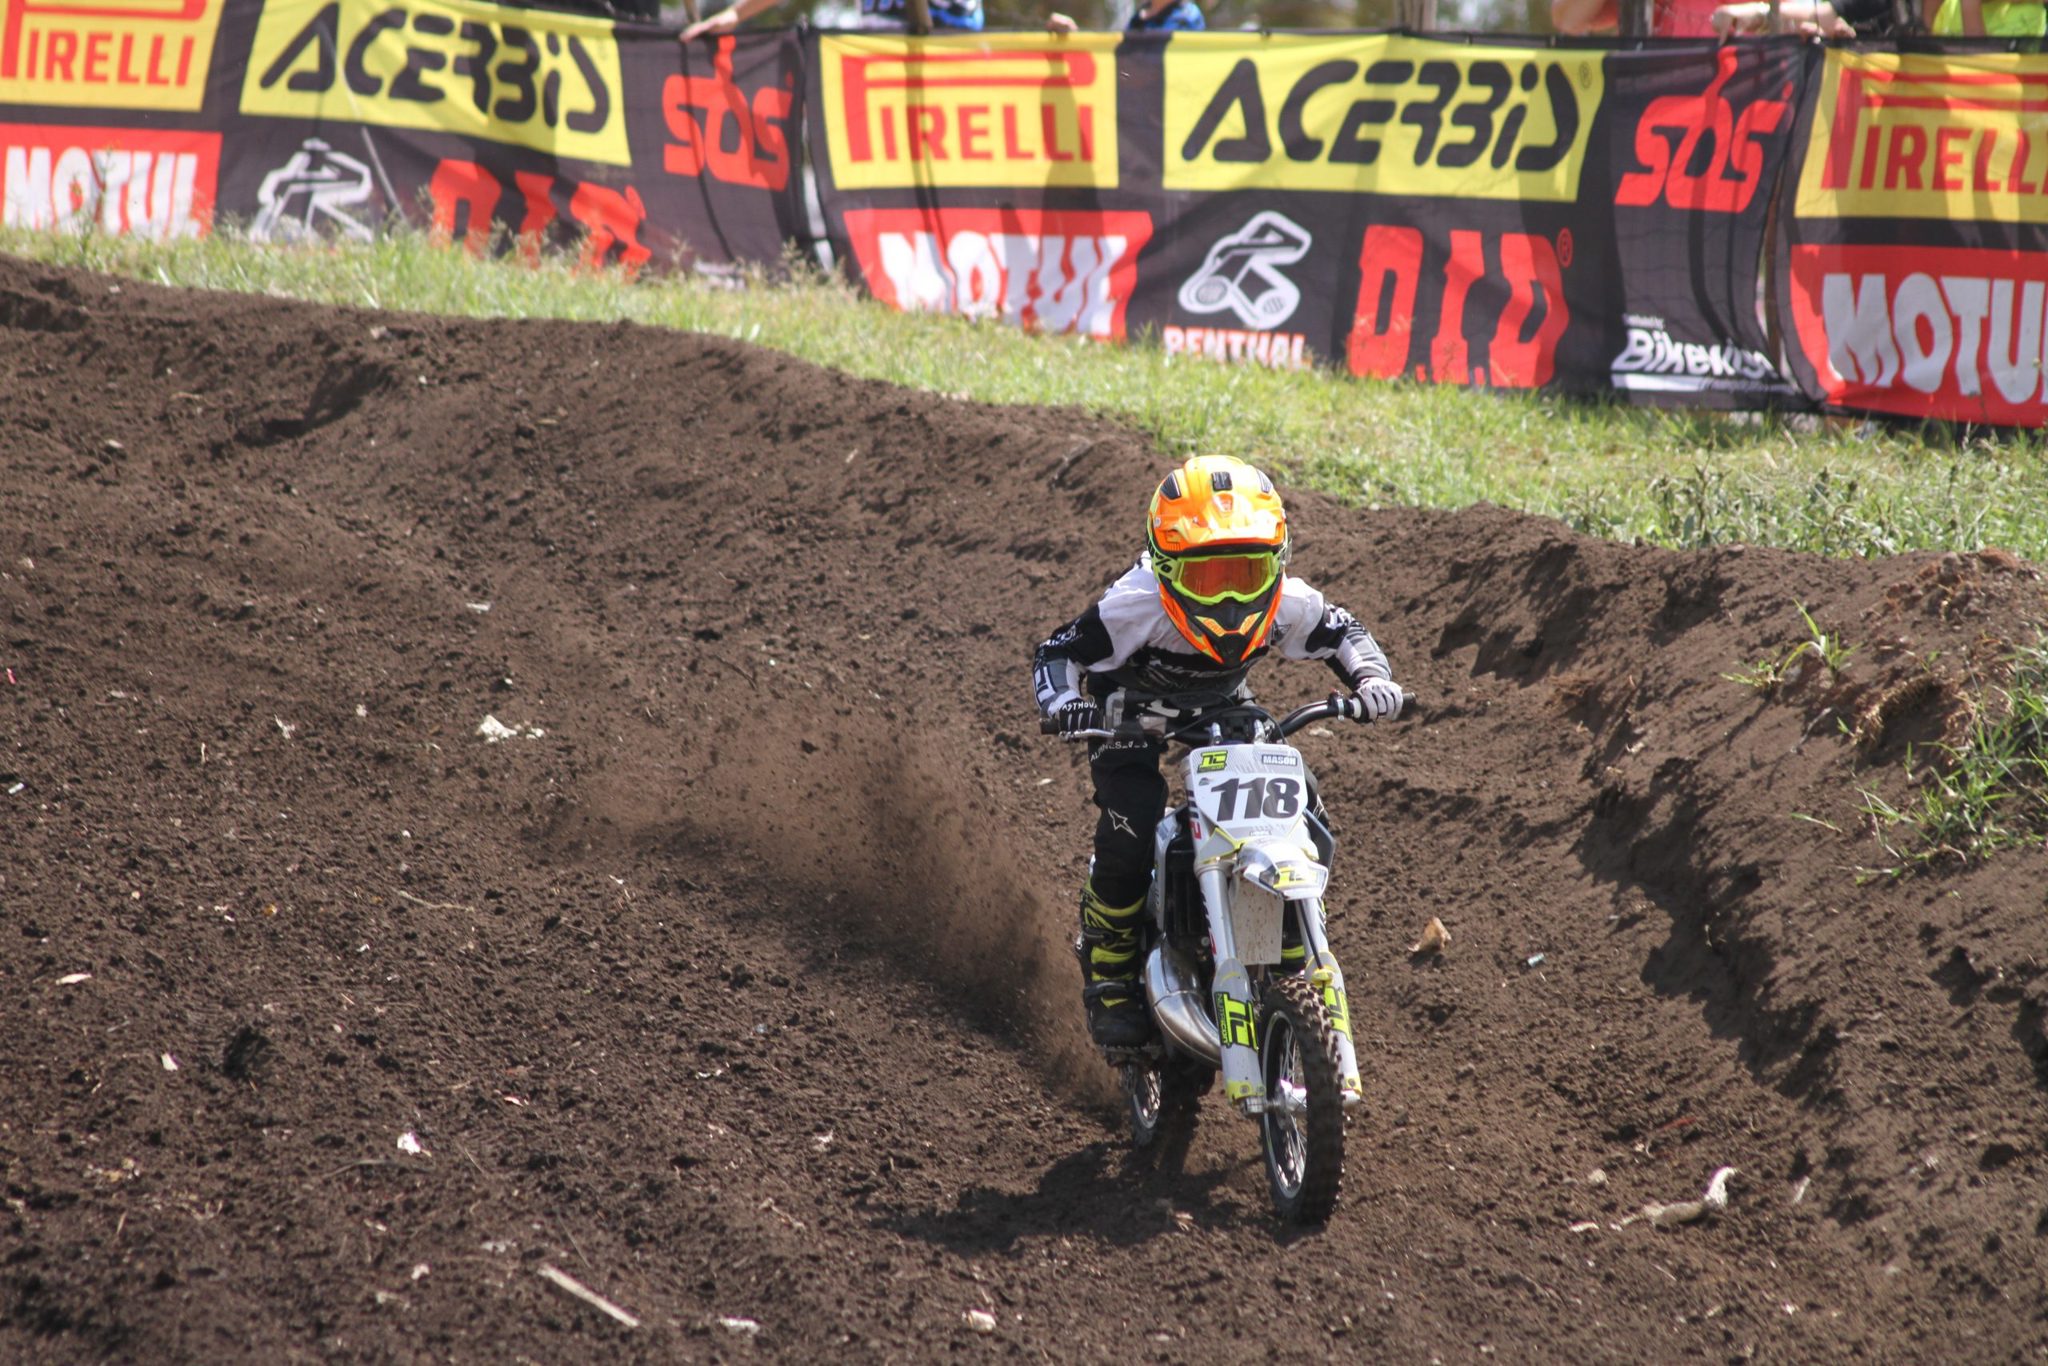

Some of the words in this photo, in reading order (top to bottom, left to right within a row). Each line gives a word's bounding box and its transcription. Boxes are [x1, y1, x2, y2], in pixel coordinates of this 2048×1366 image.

[1, 0, 207, 87] PIRELLI
[260, 2, 611, 134] ACERBIS
[841, 50, 1097, 162] PIRELLI
[1181, 58, 1580, 172] ACERBIS
[4, 145, 200, 240] MOTUL
[878, 229, 1127, 336] MOTUL
[1821, 272, 2048, 405] MOTU
[1211, 777, 1300, 822] 118
[1263, 755, 1297, 766] MASON
